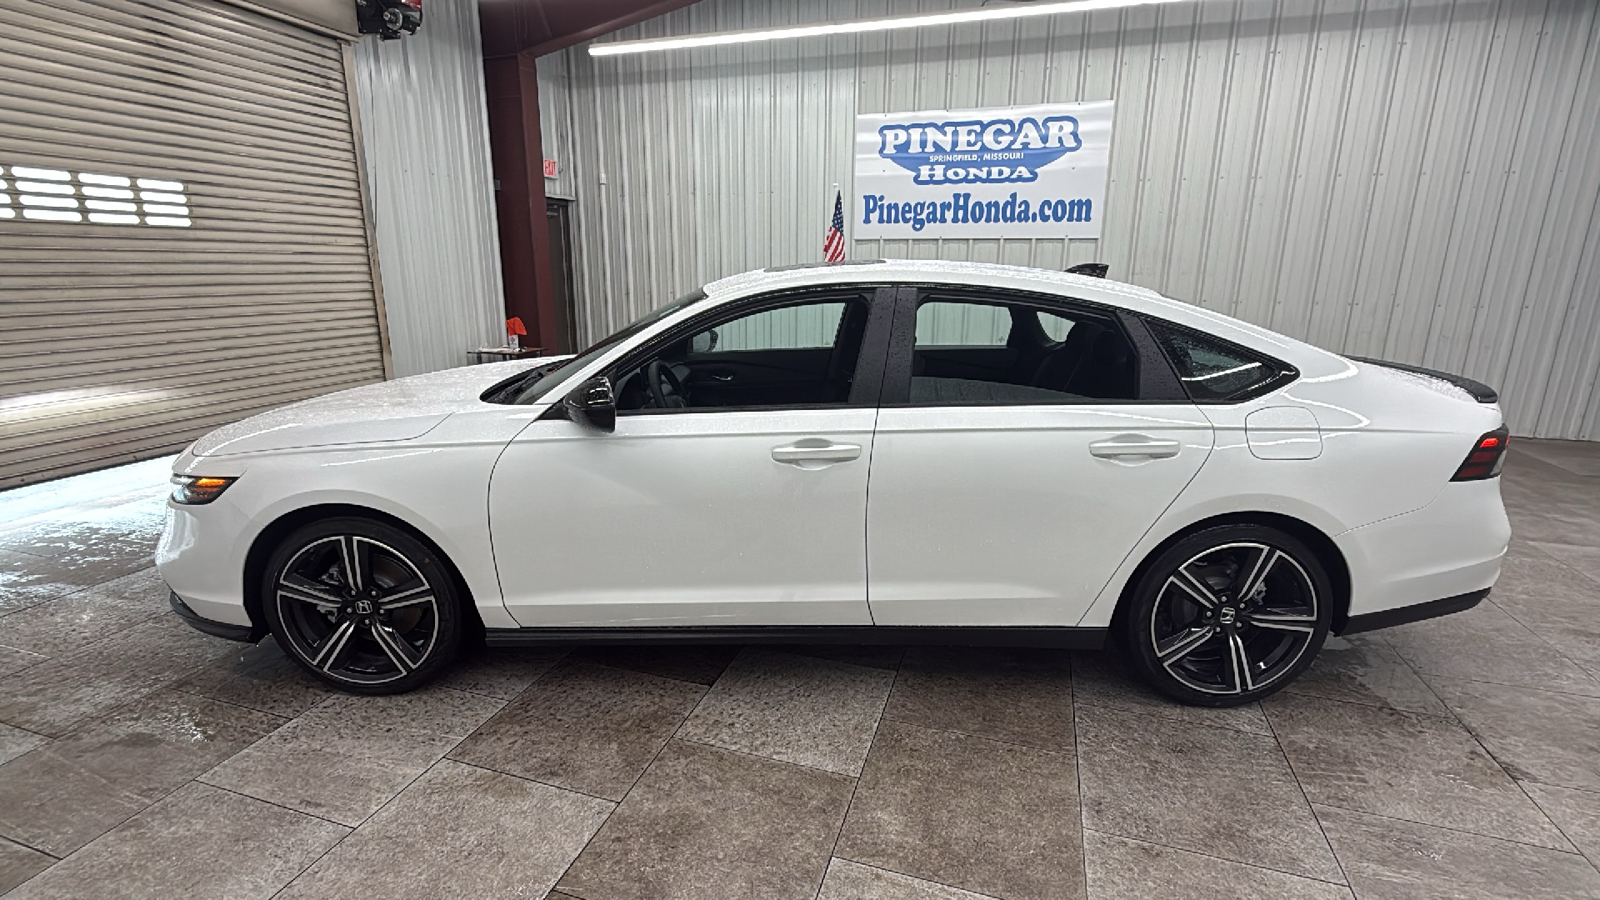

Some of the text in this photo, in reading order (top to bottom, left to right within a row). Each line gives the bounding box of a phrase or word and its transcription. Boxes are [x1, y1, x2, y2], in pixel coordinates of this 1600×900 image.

[882, 120, 1078, 155] PINEGAR
[929, 152, 1024, 163] SPRINGFIELD, MISSOURI
[917, 165, 1033, 181] HONDA
[862, 192, 1092, 232] PinegarHonda.com
